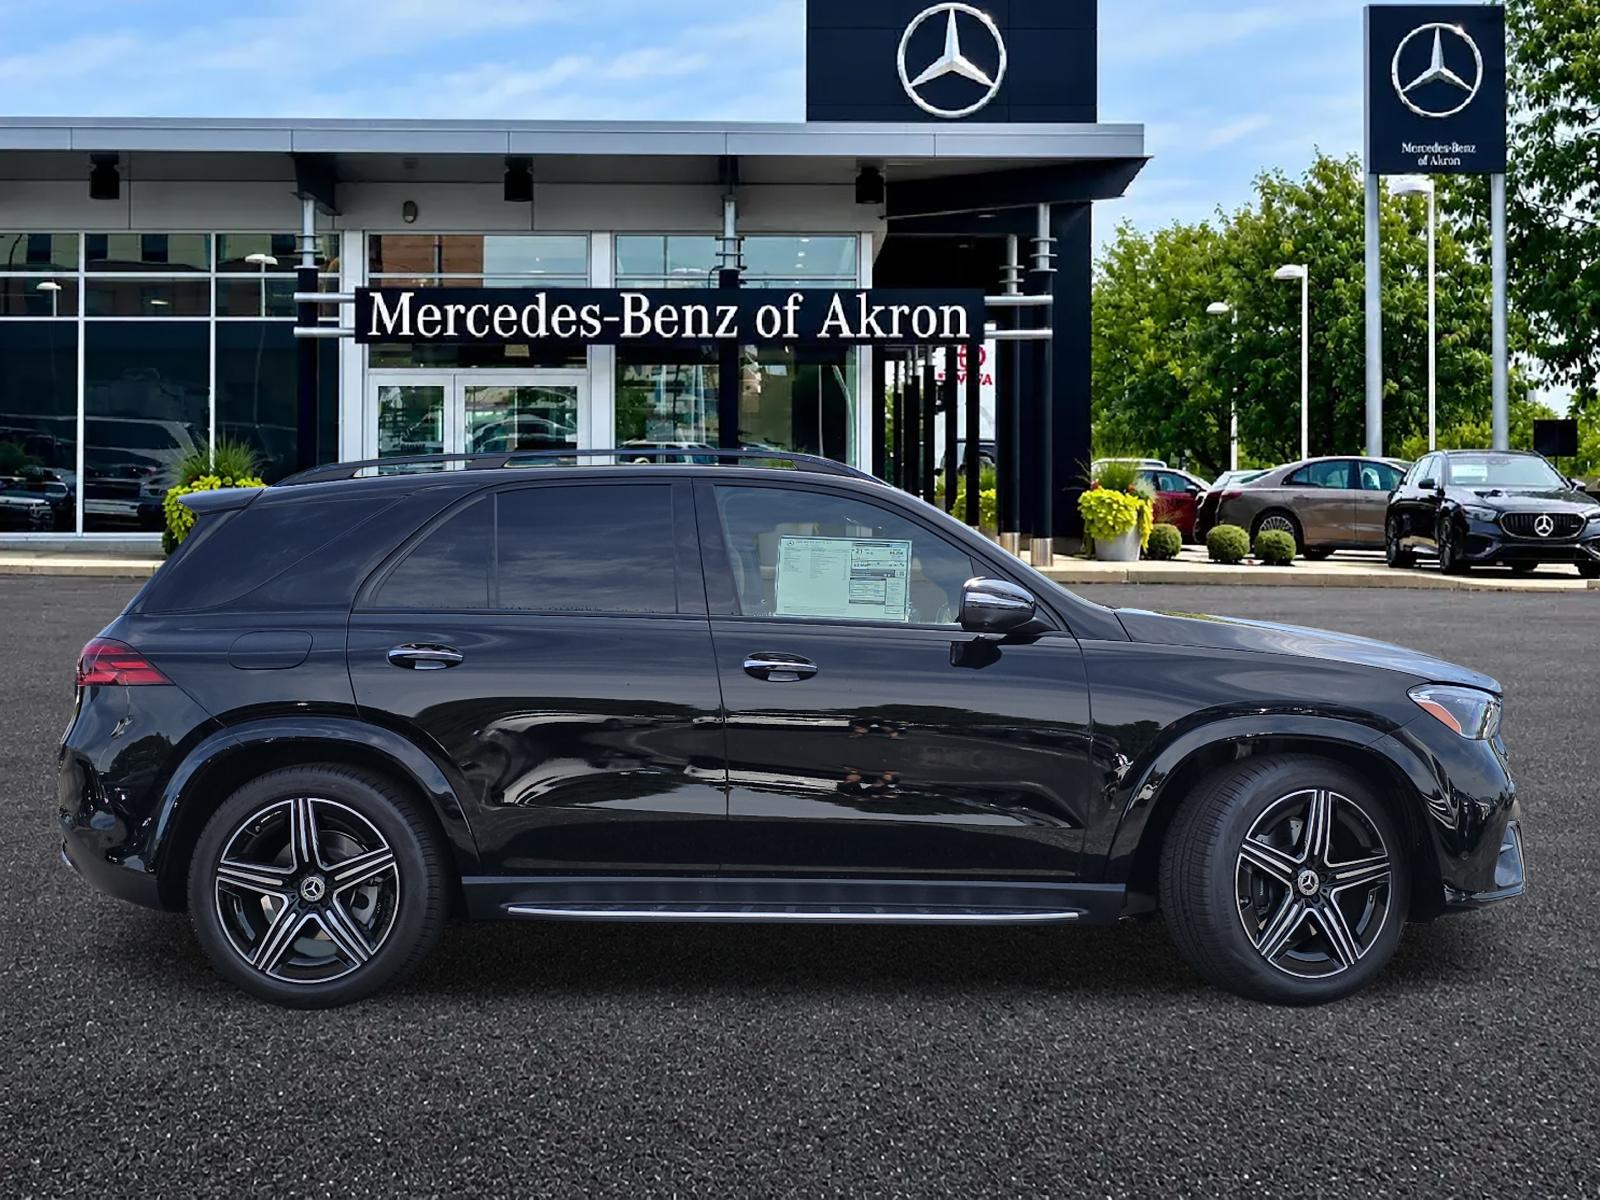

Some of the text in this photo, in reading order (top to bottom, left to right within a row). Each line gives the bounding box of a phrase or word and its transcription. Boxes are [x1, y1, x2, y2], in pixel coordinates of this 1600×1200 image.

[1401, 141, 1477, 154] Mercedes-Benz
[1417, 154, 1461, 166] of Akron
[367, 290, 971, 339] Mercedes-Benz of Akron
